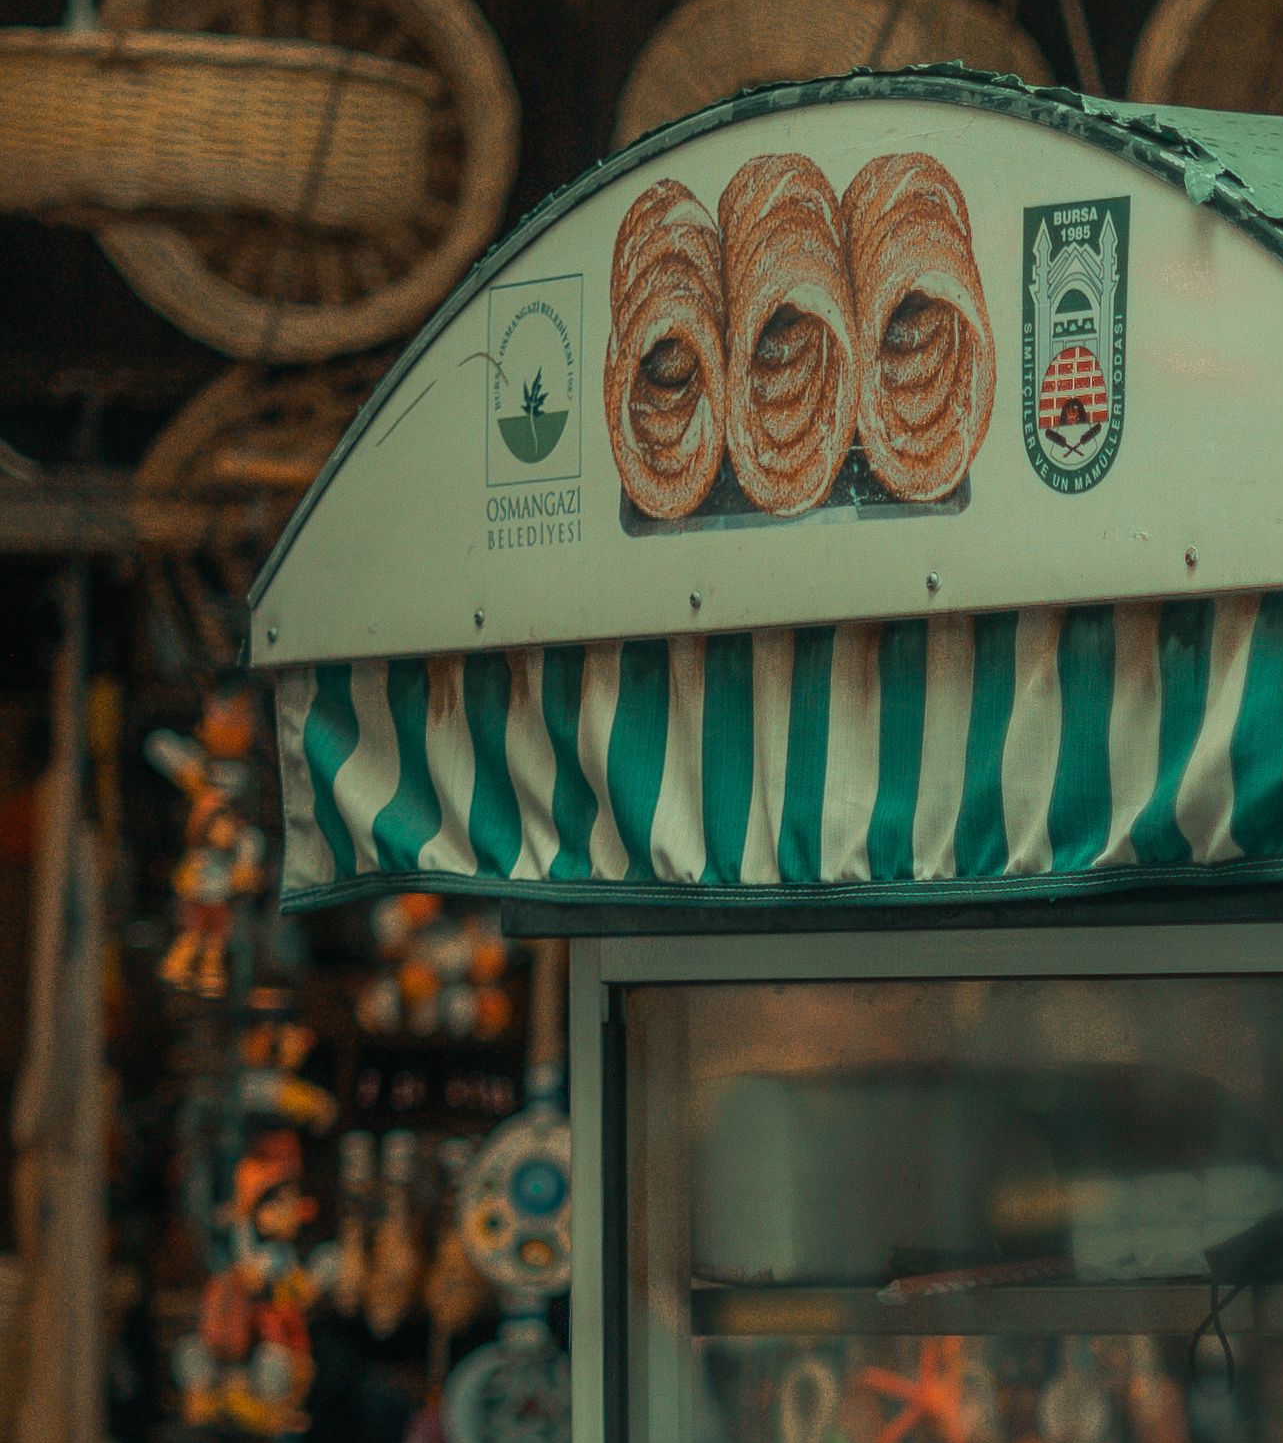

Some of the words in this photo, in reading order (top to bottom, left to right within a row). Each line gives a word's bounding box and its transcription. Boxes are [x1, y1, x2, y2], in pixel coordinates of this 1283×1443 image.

[1053, 206, 1098, 226] BURSA
[1060, 225, 1091, 242] 1985
[1035, 453, 1050, 479] VE
[1052, 474, 1068, 492] UN
[486, 485, 580, 522] OSMANGAZİ
[488, 519, 581, 550] BELEDİYESİ
